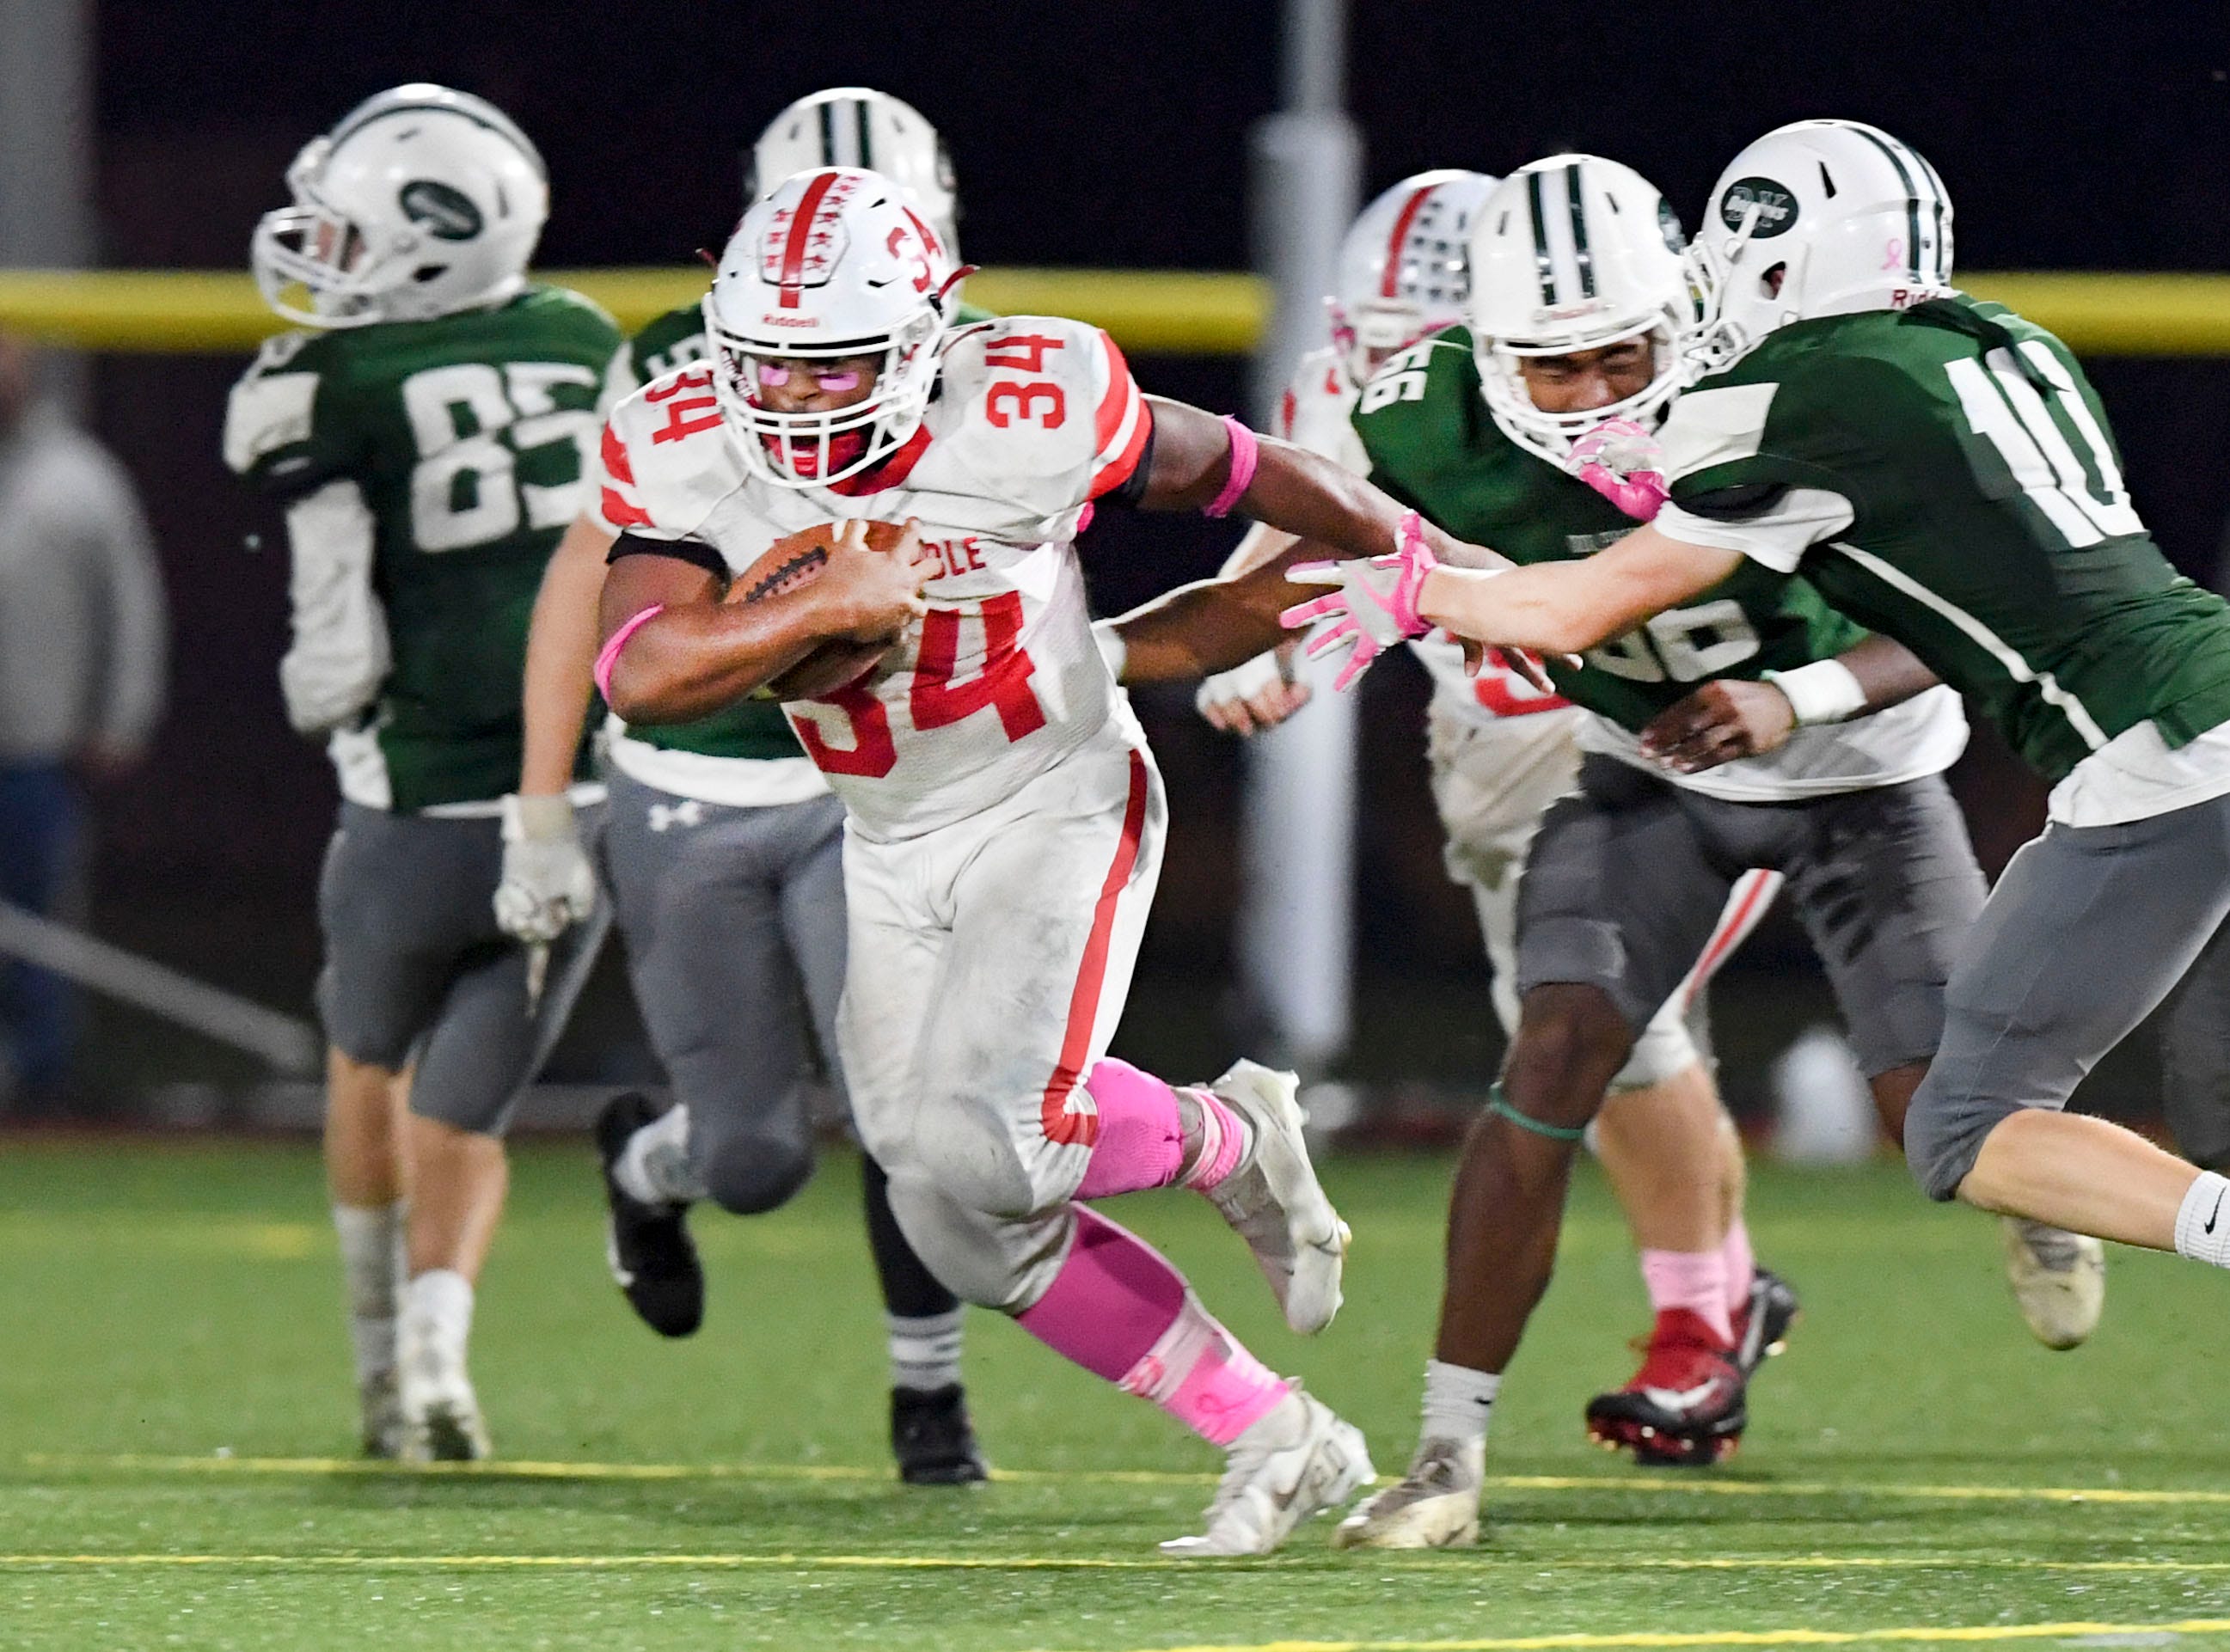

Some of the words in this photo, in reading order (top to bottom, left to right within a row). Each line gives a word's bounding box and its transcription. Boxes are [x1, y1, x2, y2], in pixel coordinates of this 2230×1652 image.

[645, 369, 725, 445] 34
[984, 334, 1066, 429] 34
[1942, 340, 2148, 548] 10
[402, 362, 602, 554] 85
